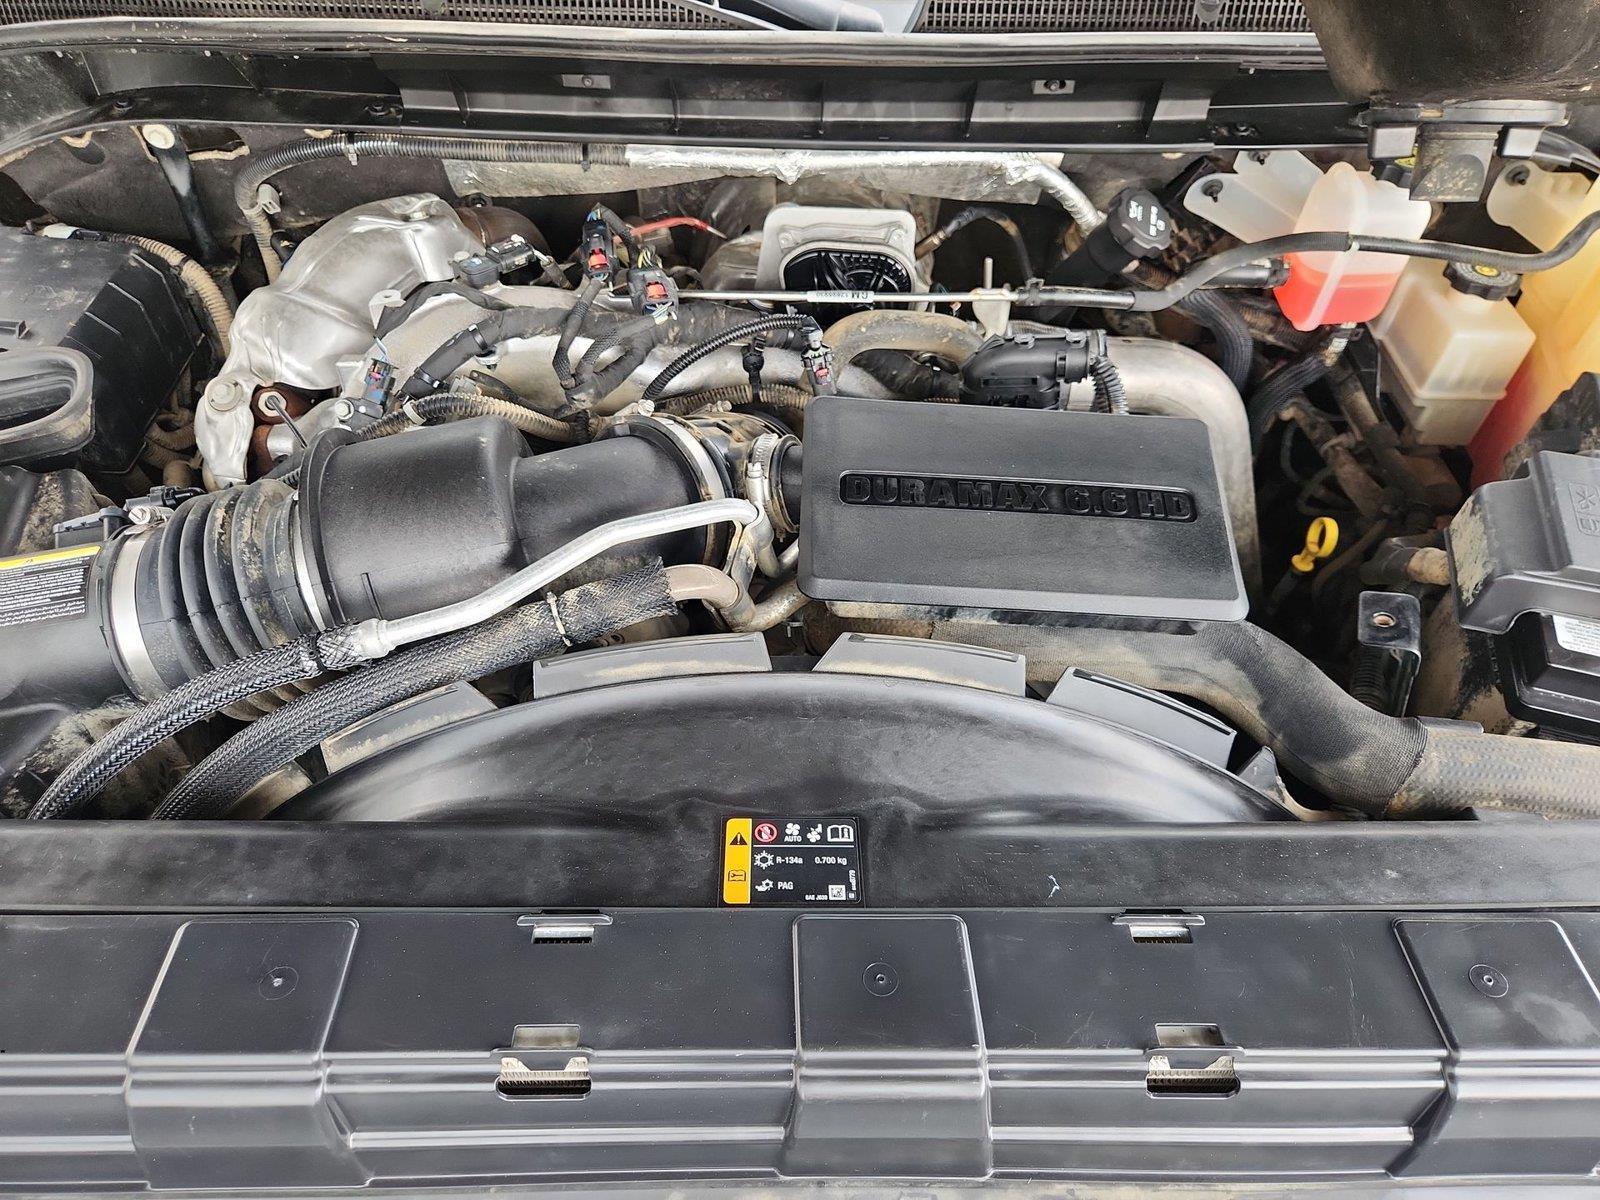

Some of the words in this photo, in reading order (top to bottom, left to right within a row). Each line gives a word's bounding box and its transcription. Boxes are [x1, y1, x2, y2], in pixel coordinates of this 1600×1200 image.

[845, 475, 1049, 511] DURAMAX
[1064, 487, 1130, 516] 6.6
[1139, 490, 1193, 520] HD
[837, 857, 847, 865] kg
